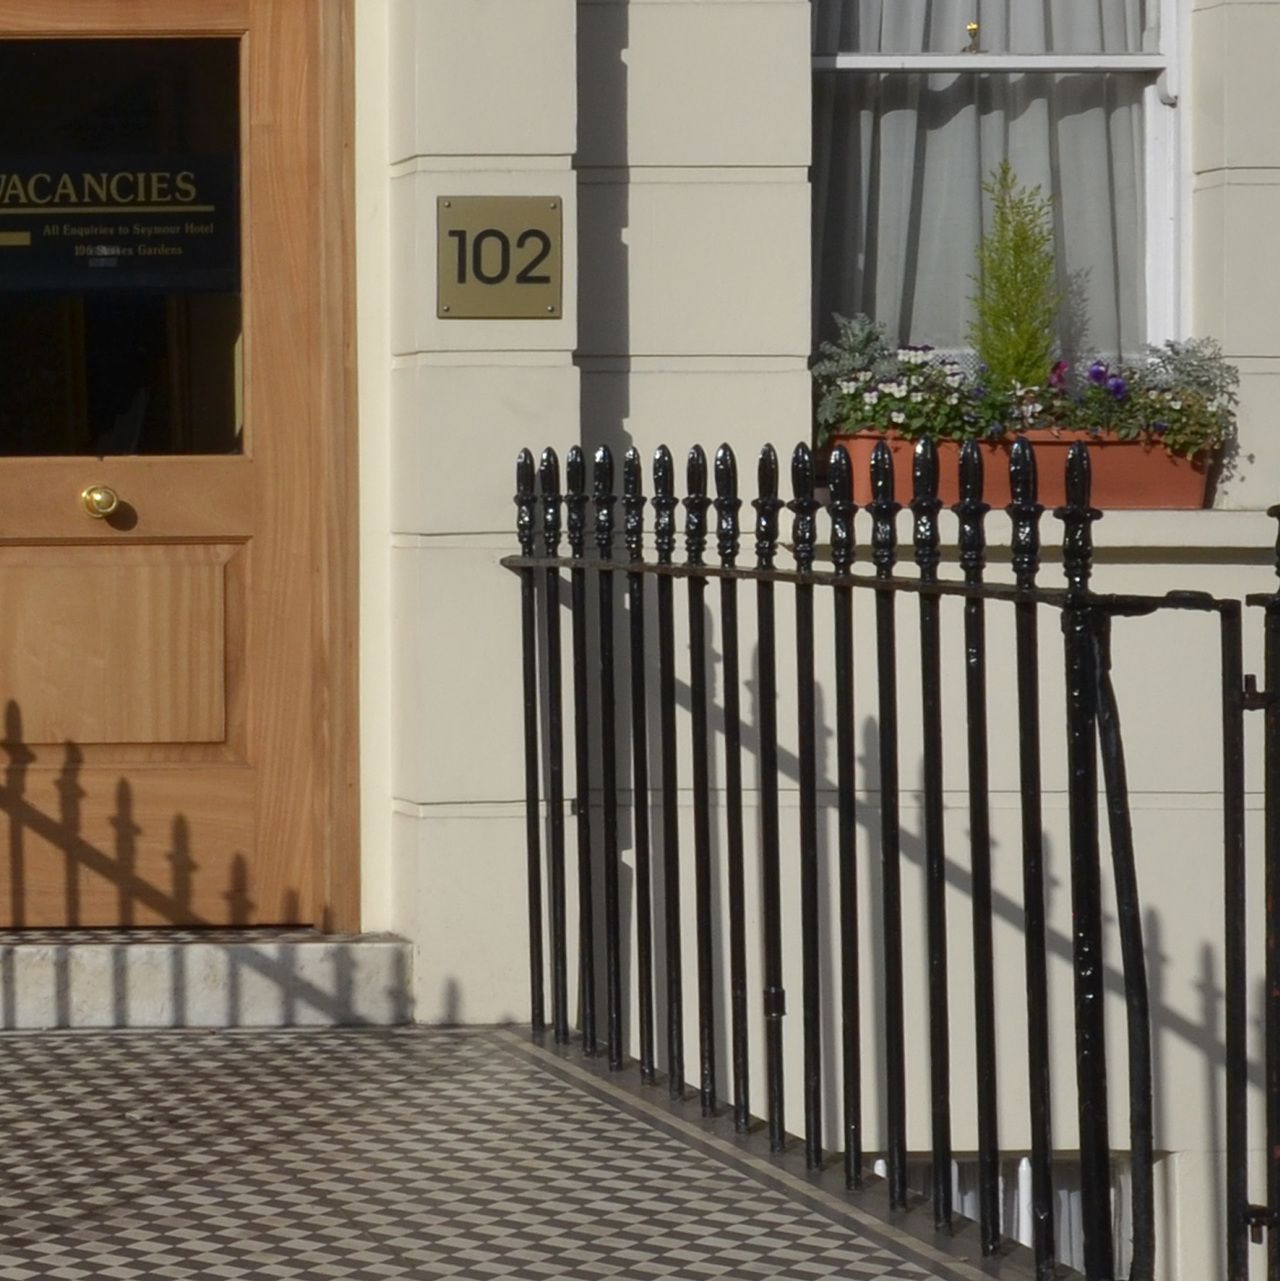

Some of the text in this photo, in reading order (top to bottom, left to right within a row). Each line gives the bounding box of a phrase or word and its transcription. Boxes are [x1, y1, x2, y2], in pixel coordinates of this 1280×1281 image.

[42, 222, 214, 238] All Enquiries to Seymour Hotel
[137, 243, 184, 256] Gardens
[448, 228, 552, 286] 102
